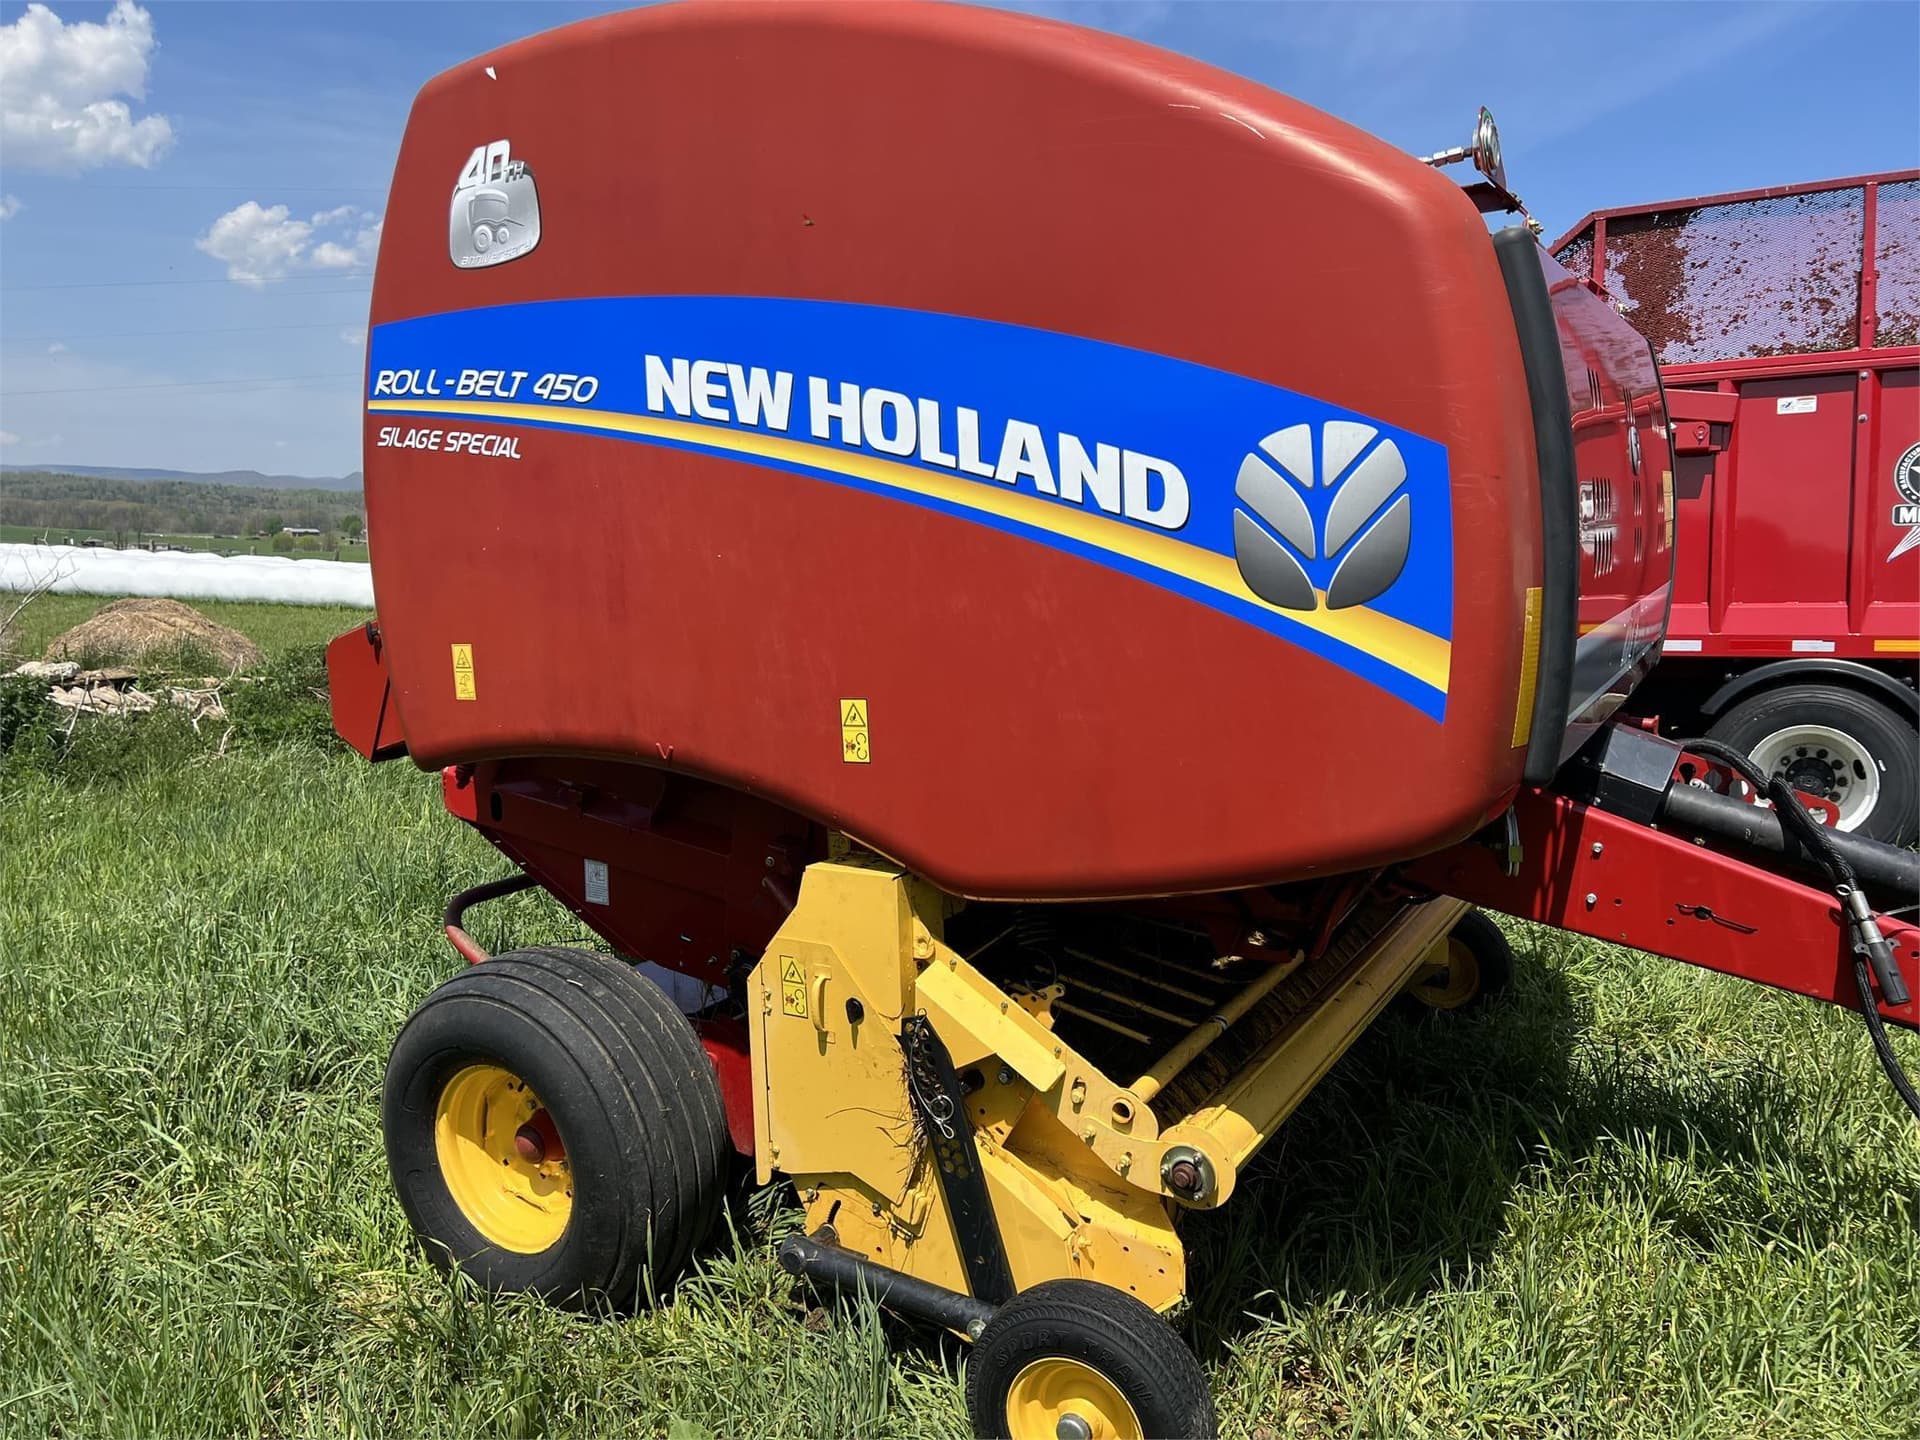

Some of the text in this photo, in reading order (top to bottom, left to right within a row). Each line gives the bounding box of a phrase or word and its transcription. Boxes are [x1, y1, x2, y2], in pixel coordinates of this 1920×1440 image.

[374, 368, 599, 403] ROLL-BELT 450
[377, 426, 522, 459] SILAGE SPECIAL
[644, 353, 1191, 531] NEW HOLLAND
[1899, 506, 1920, 523] M
